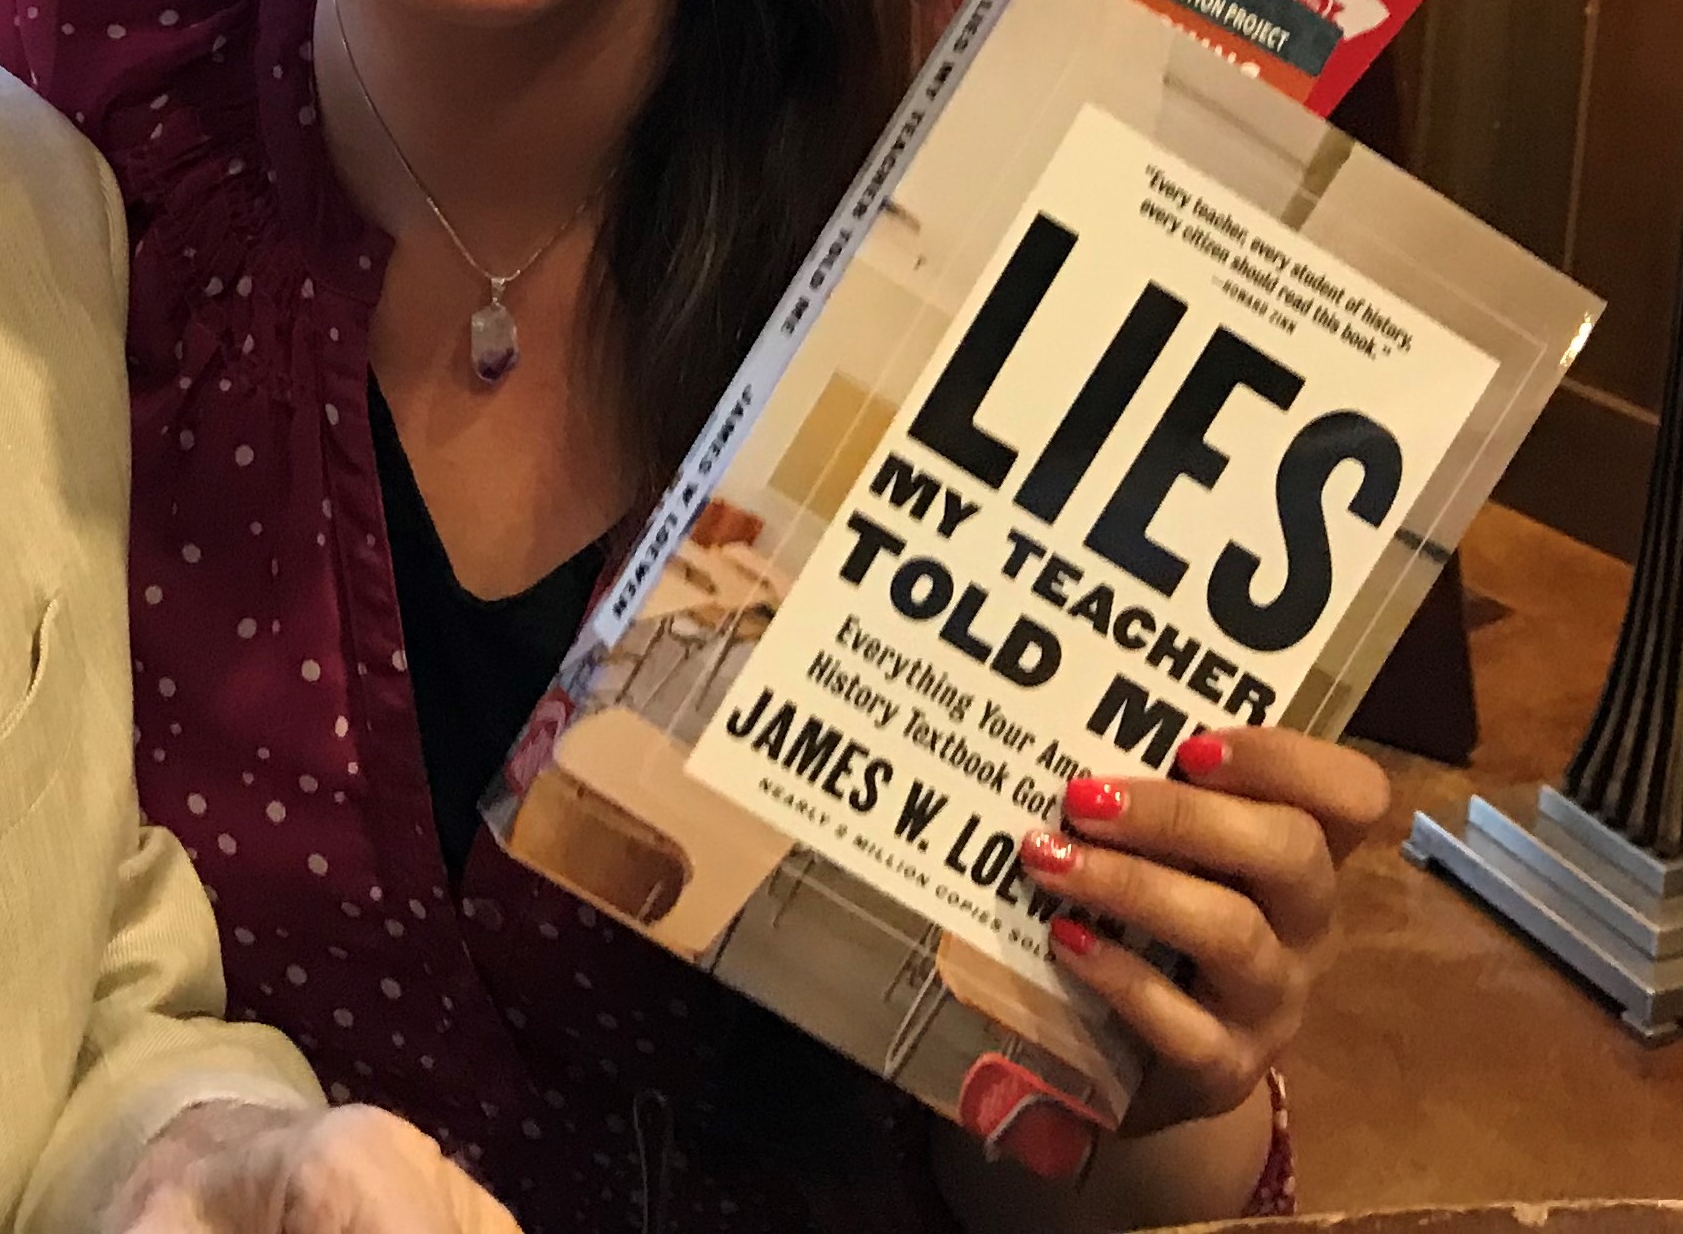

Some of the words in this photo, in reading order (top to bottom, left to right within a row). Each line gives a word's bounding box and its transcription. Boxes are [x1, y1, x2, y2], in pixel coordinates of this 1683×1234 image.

[1224, 1, 1290, 53] PROJECT
[1140, 197, 1183, 237] every
[1181, 223, 1230, 265] citizen
[1229, 254, 1280, 295] should
[1277, 284, 1314, 317] read
[1312, 304, 1341, 336] this
[1192, 196, 1248, 248] teacher,
[1249, 236, 1291, 272] every
[1290, 262, 1346, 306] student
[1345, 297, 1364, 316] of
[1269, 308, 1298, 336] ZINN
[907, 210, 1403, 652] LIES
[838, 509, 1063, 689] TOLD
[1086, 671, 1214, 780] M
[868, 450, 980, 541] MY
[1001, 526, 1277, 727] TEACHER
[807, 649, 900, 729] History
[903, 706, 1010, 796] Textbook
[1012, 775, 1058, 822] Got
[835, 614, 975, 723] Everything
[978, 699, 1037, 754] Your
[726, 687, 894, 814] JAMES
[894, 778, 949, 853] W.
[759, 777, 830, 826] NEARLY
[853, 834, 931, 888] MILLION
[935, 884, 1002, 932] COPIES
